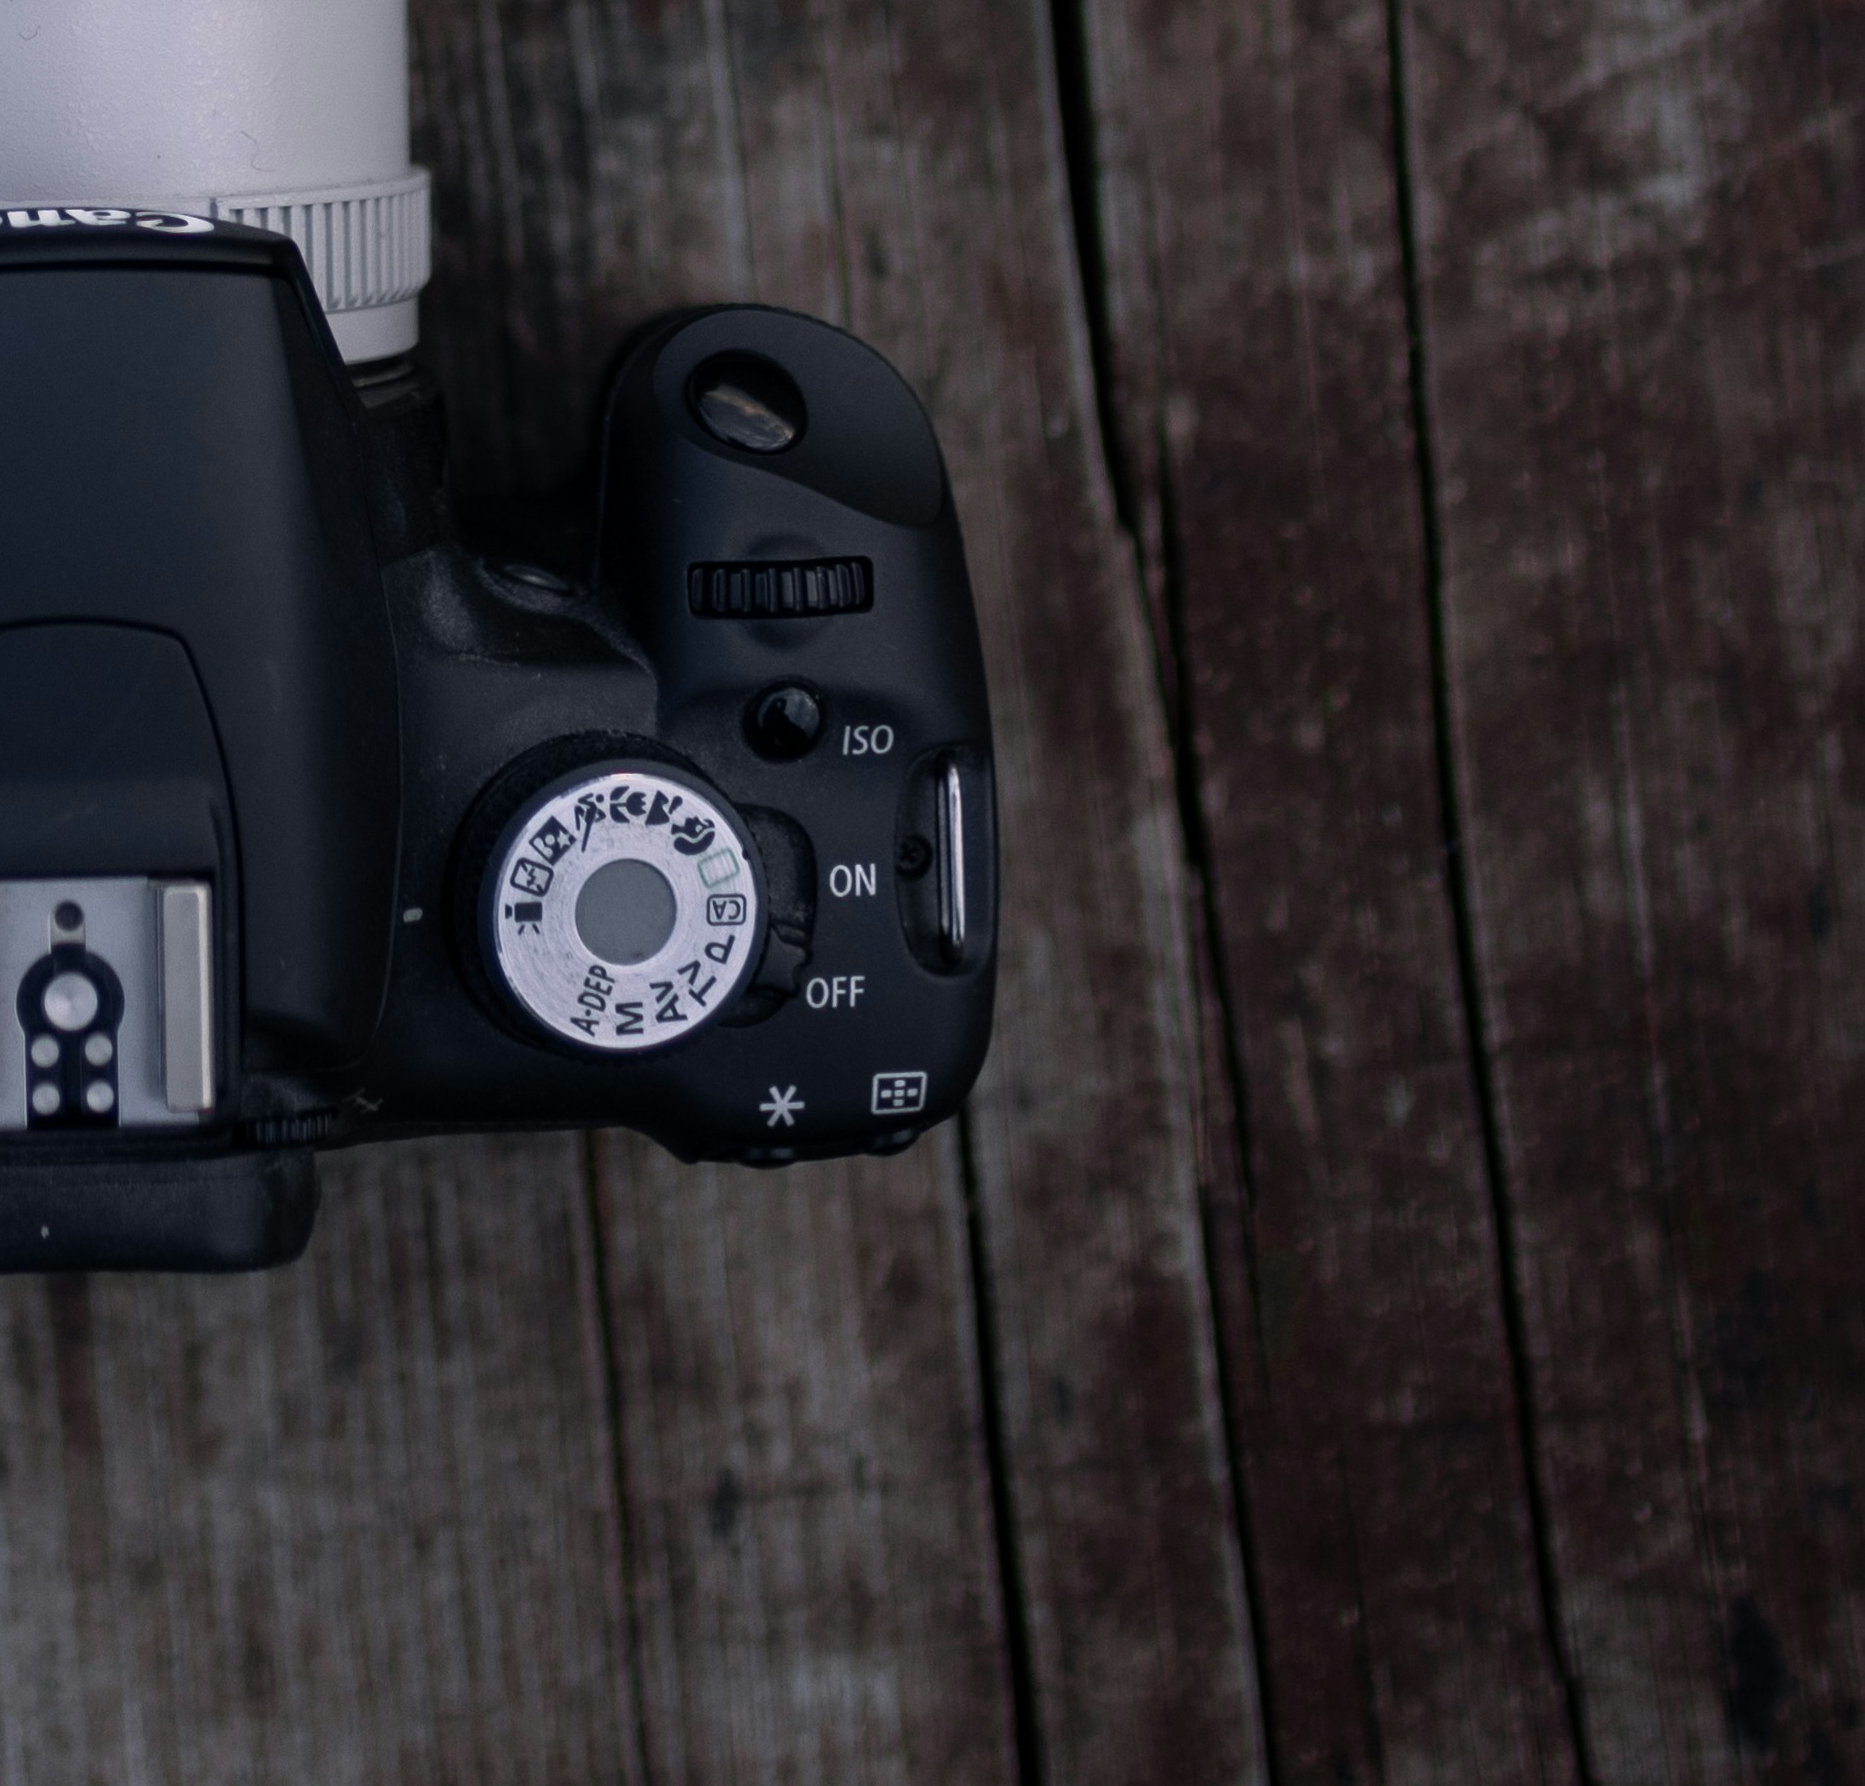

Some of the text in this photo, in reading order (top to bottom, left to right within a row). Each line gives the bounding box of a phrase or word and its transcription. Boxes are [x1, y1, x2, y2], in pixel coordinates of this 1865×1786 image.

[841, 724, 894, 756] ISO
[829, 862, 876, 898] ON
[712, 900, 741, 920] CA
[704, 934, 735, 964] P
[805, 975, 865, 1009] OFF
[615, 1002, 644, 1036] M
